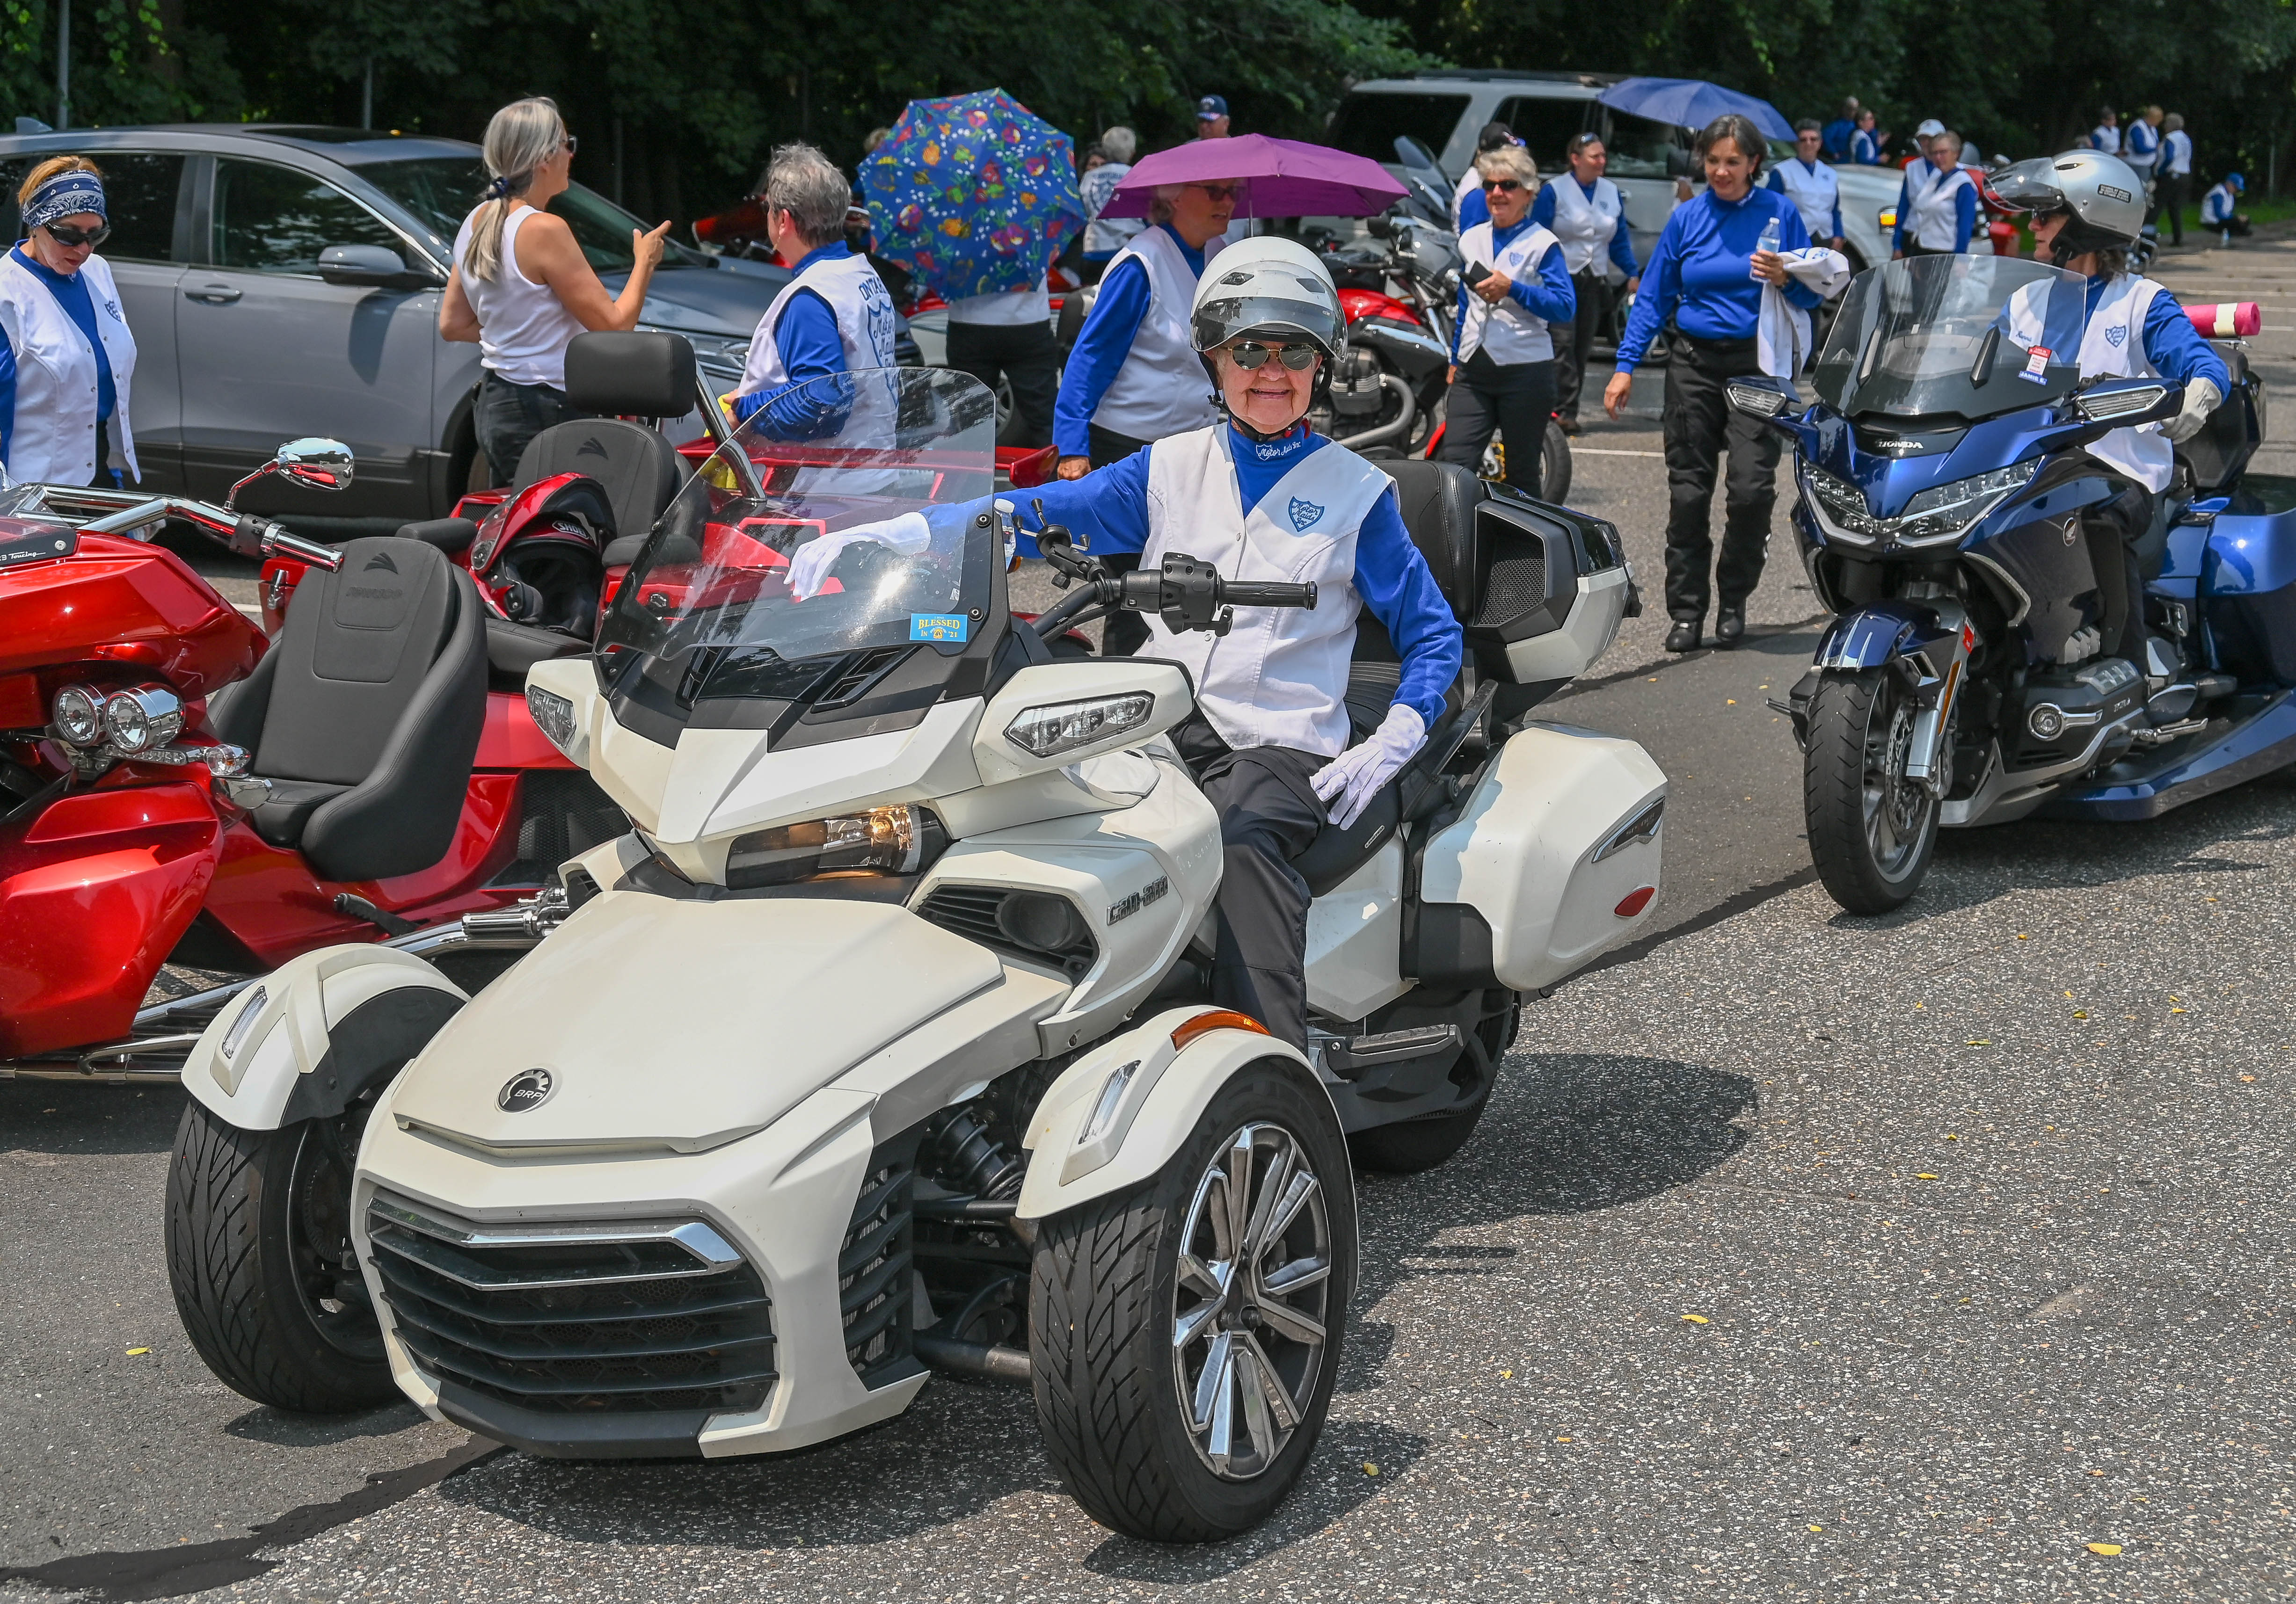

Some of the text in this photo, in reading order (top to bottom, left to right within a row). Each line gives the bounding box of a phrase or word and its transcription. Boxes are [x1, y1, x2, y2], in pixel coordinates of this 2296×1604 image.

[2020, 371, 2039, 382] JAMIE
[1258, 447, 1281, 457] Motor
[1292, 503, 1318, 515] Motor
[1292, 510, 1315, 521] Maids
[918, 619, 960, 629] BLESSED
[1626, 813, 1655, 835] SPDER
[514, 1089, 542, 1098] BRP
